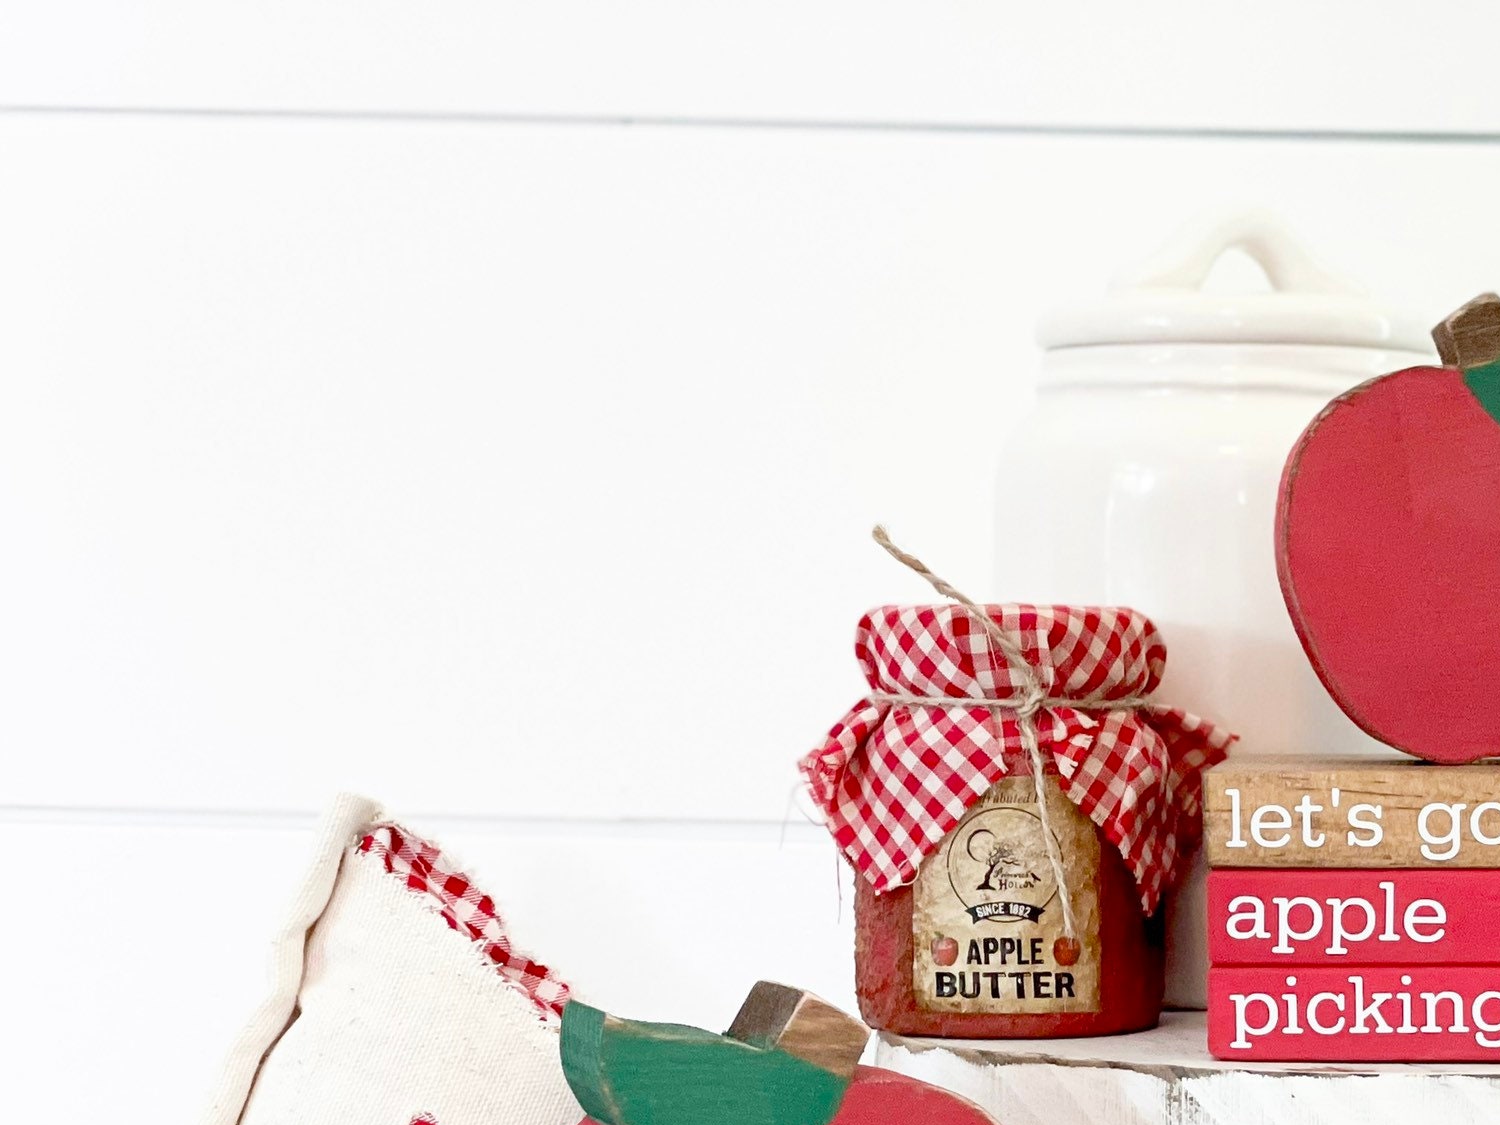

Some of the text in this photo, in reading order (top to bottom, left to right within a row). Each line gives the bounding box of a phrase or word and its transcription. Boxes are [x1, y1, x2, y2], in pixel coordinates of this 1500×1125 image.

[1225, 787, 1384, 848] let's
[976, 902, 1005, 918] SINCE
[1225, 881, 1447, 955] apple
[966, 937, 1044, 965] APPLE
[935, 971, 1076, 999] BUTTER
